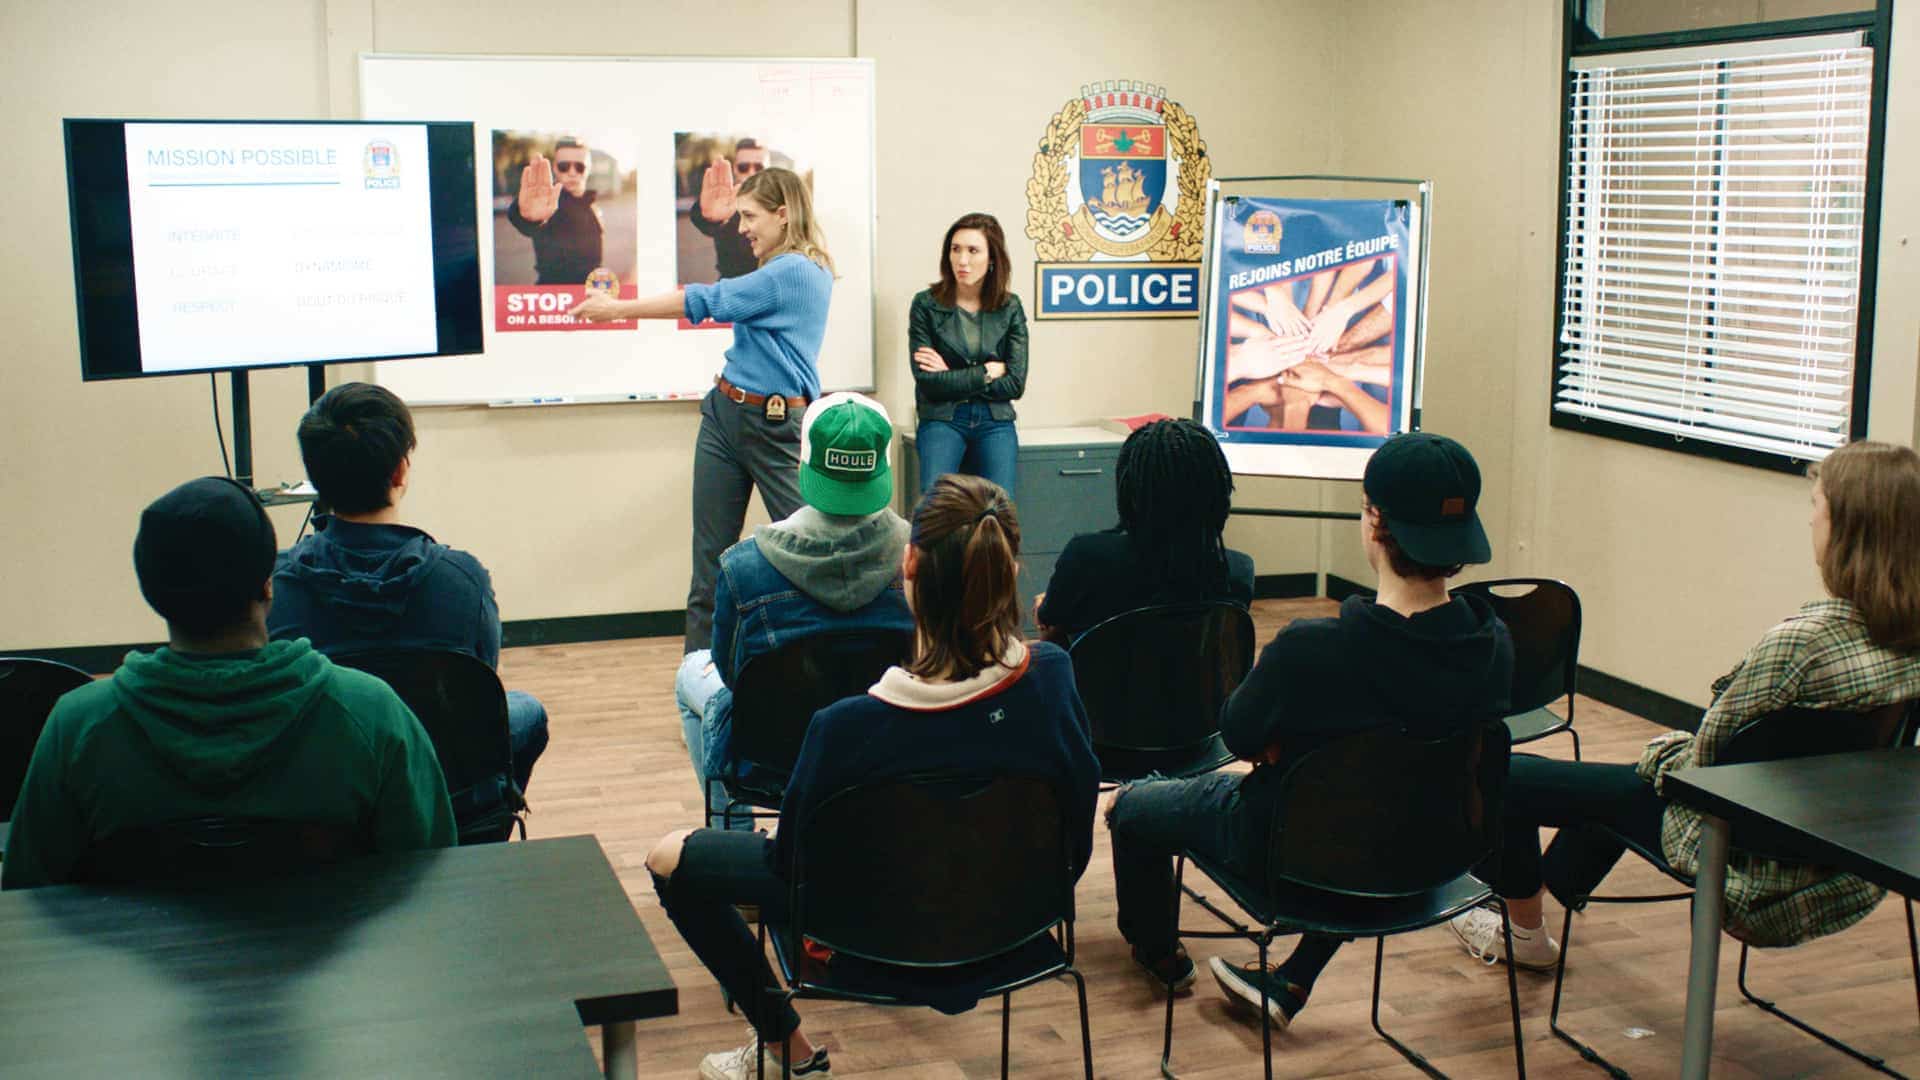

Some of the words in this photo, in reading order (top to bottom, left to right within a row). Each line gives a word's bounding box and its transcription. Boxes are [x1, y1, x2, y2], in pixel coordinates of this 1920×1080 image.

[147, 149, 235, 166] MISSION
[241, 148, 337, 166] POSSIBLE
[1229, 262, 1291, 290] REJOINS
[1294, 247, 1343, 274] NOTRE
[1346, 234, 1400, 260] ÉQUIPE
[1051, 274, 1193, 306] POLICE
[507, 293, 573, 312] STOP
[507, 315, 525, 325] ON
[528, 315, 537, 324] A
[539, 314, 576, 324] BESOI
[830, 454, 874, 466] HOULE
